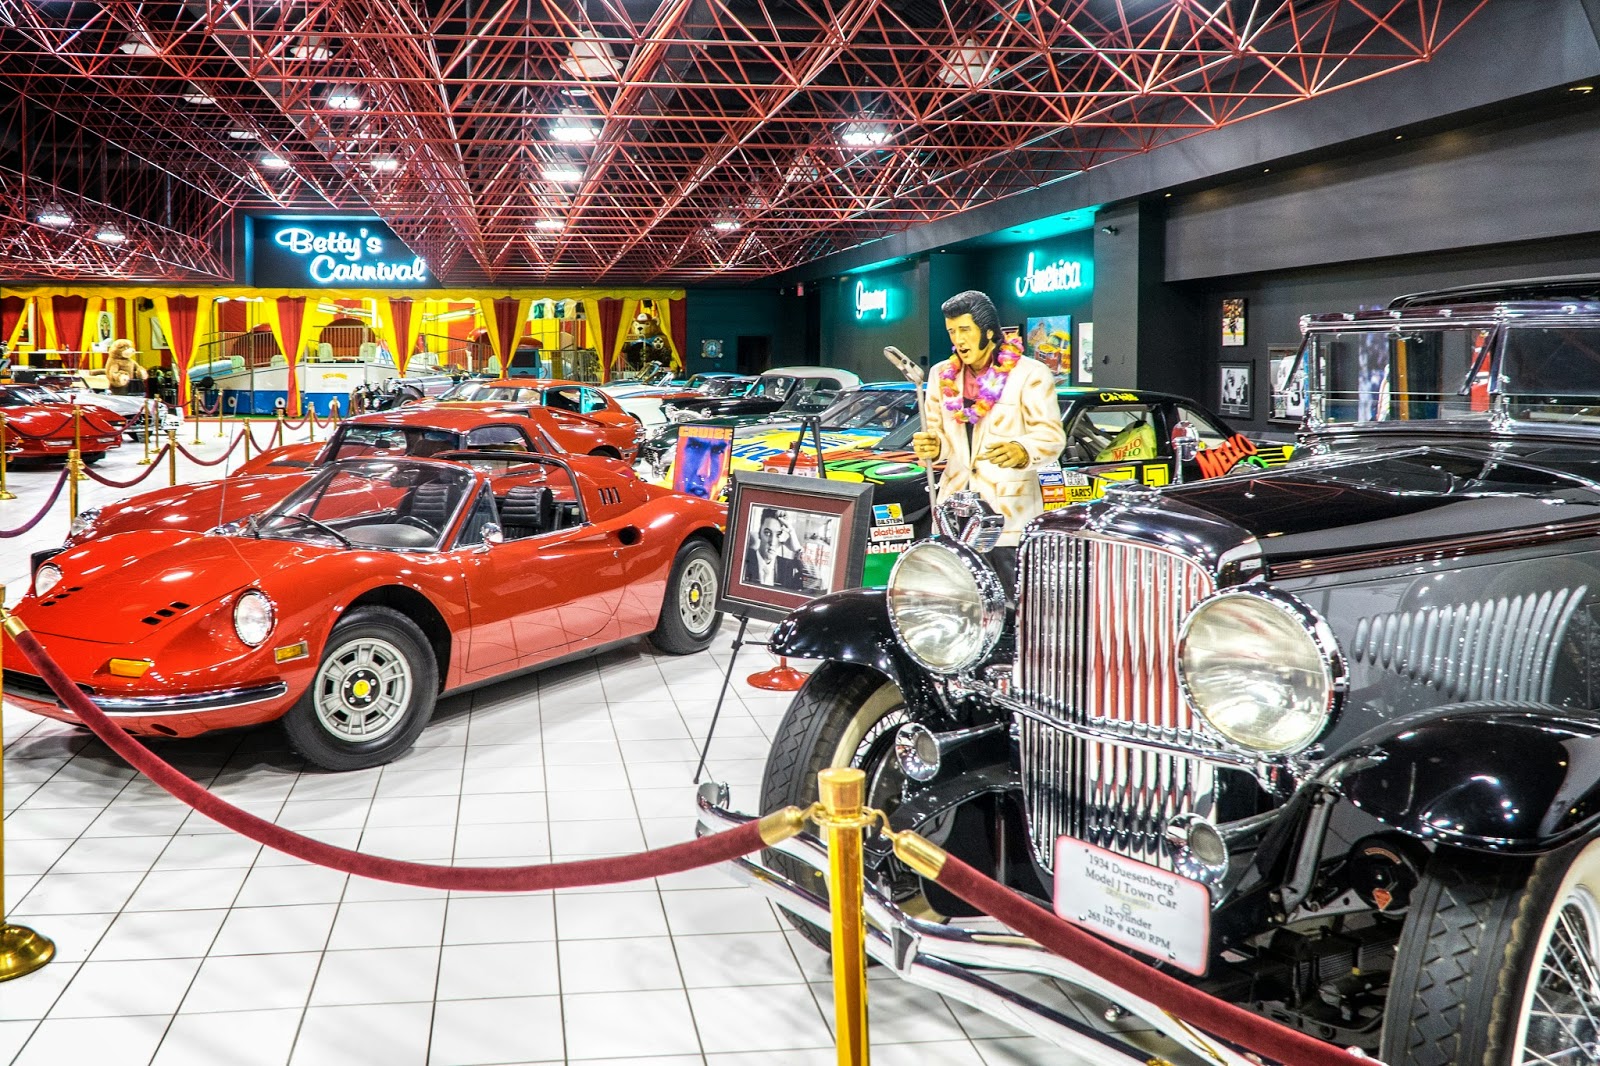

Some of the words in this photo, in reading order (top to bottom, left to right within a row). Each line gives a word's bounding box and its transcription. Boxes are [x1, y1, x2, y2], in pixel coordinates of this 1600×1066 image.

[275, 227, 383, 260] Betty's
[309, 255, 427, 283] Carnival
[679, 426, 733, 440] CRUISE
[1195, 433, 1257, 479] MELLO
[867, 540, 911, 554] ieHard
[1085, 867, 1114, 888] Model
[1124, 883, 1154, 902] Town
[1157, 894, 1177, 909] Car
[1089, 854, 1109, 870] 1934
[1112, 863, 1174, 896] Duesenberg
[1149, 934, 1171, 949] RPM
